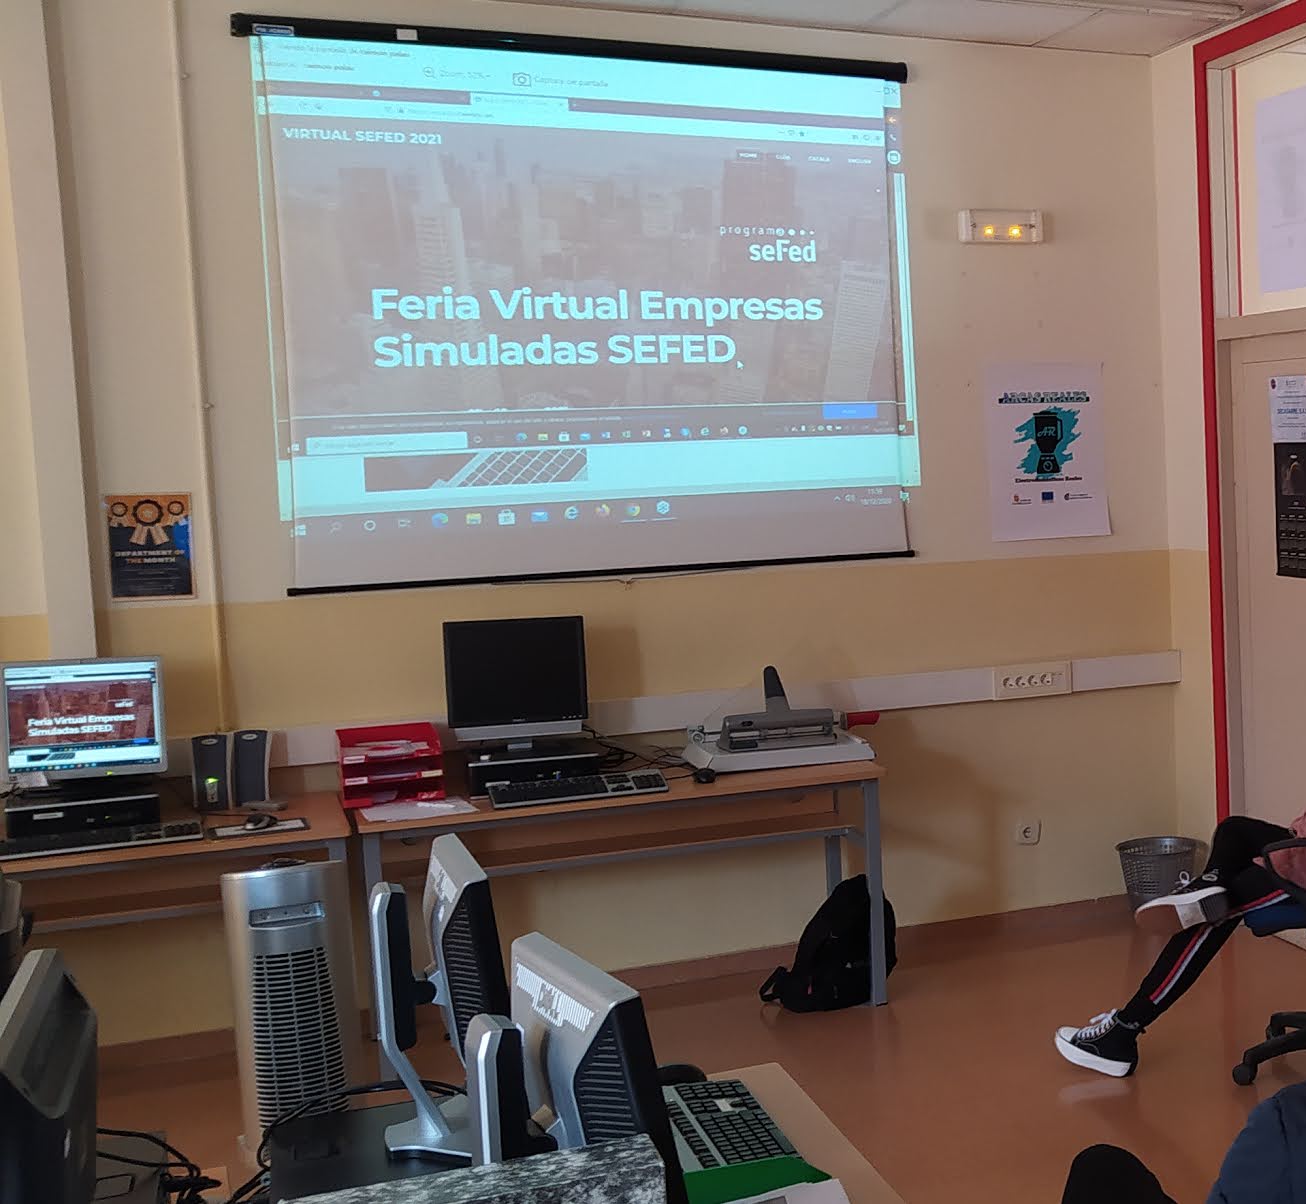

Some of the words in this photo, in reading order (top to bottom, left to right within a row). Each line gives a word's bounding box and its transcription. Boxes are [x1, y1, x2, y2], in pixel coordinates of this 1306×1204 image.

[281, 127, 351, 142] VIRTUAL
[355, 129, 405, 144] SEFED
[409, 131, 443, 145] 2021
[748, 239, 816, 262] seFed
[371, 286, 480, 321] Feria
[489, 287, 629, 322] Virtual
[640, 290, 824, 328] Empresas
[374, 332, 599, 369] Simuladas
[607, 334, 737, 366] SEFED
[1044, 391, 1088, 403] REALES
[28, 717, 53, 727] Feria
[54, 716, 87, 725] Virtual
[88, 714, 135, 725] Empresas
[28, 725, 80, 737] Simuladas
[80, 724, 114, 734] SEFED
